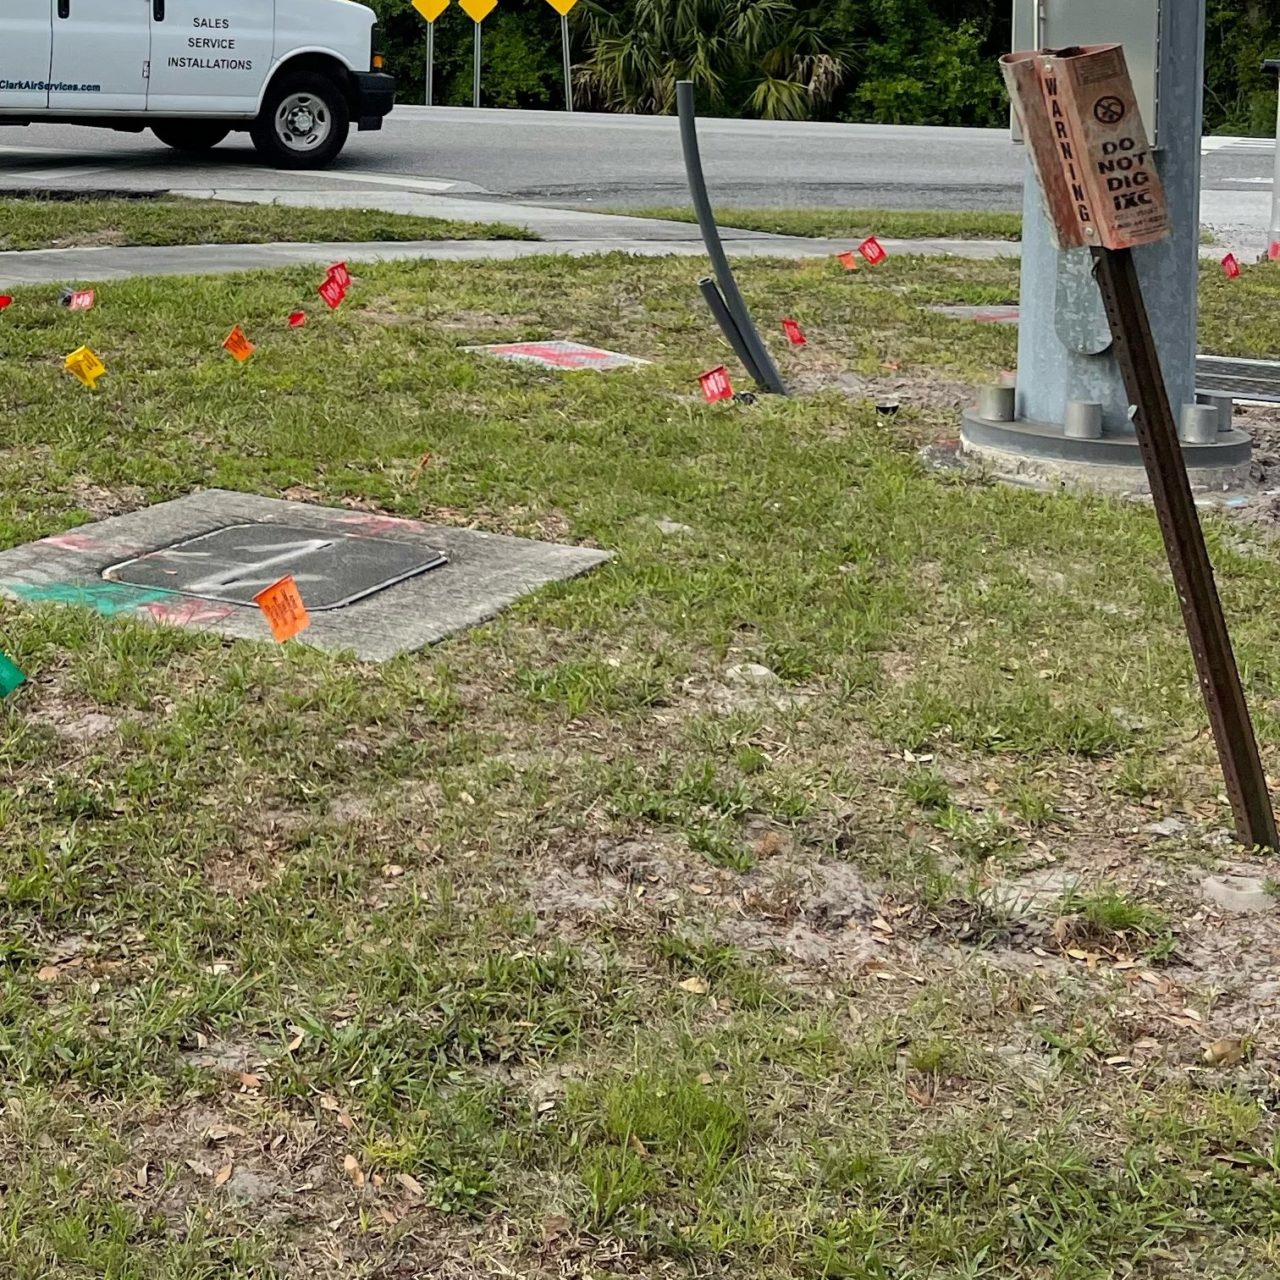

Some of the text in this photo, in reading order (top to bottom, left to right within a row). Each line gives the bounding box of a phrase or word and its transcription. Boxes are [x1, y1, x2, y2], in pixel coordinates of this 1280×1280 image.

[192, 17, 230, 29] SALES
[187, 37, 236, 50] SERVICE
[167, 57, 253, 70] INSTALLATIONS
[1044, 77, 1091, 222] WARNING
[1102, 137, 1135, 156] DO
[1097, 151, 1147, 175] NOT
[1106, 171, 1149, 192] DIG
